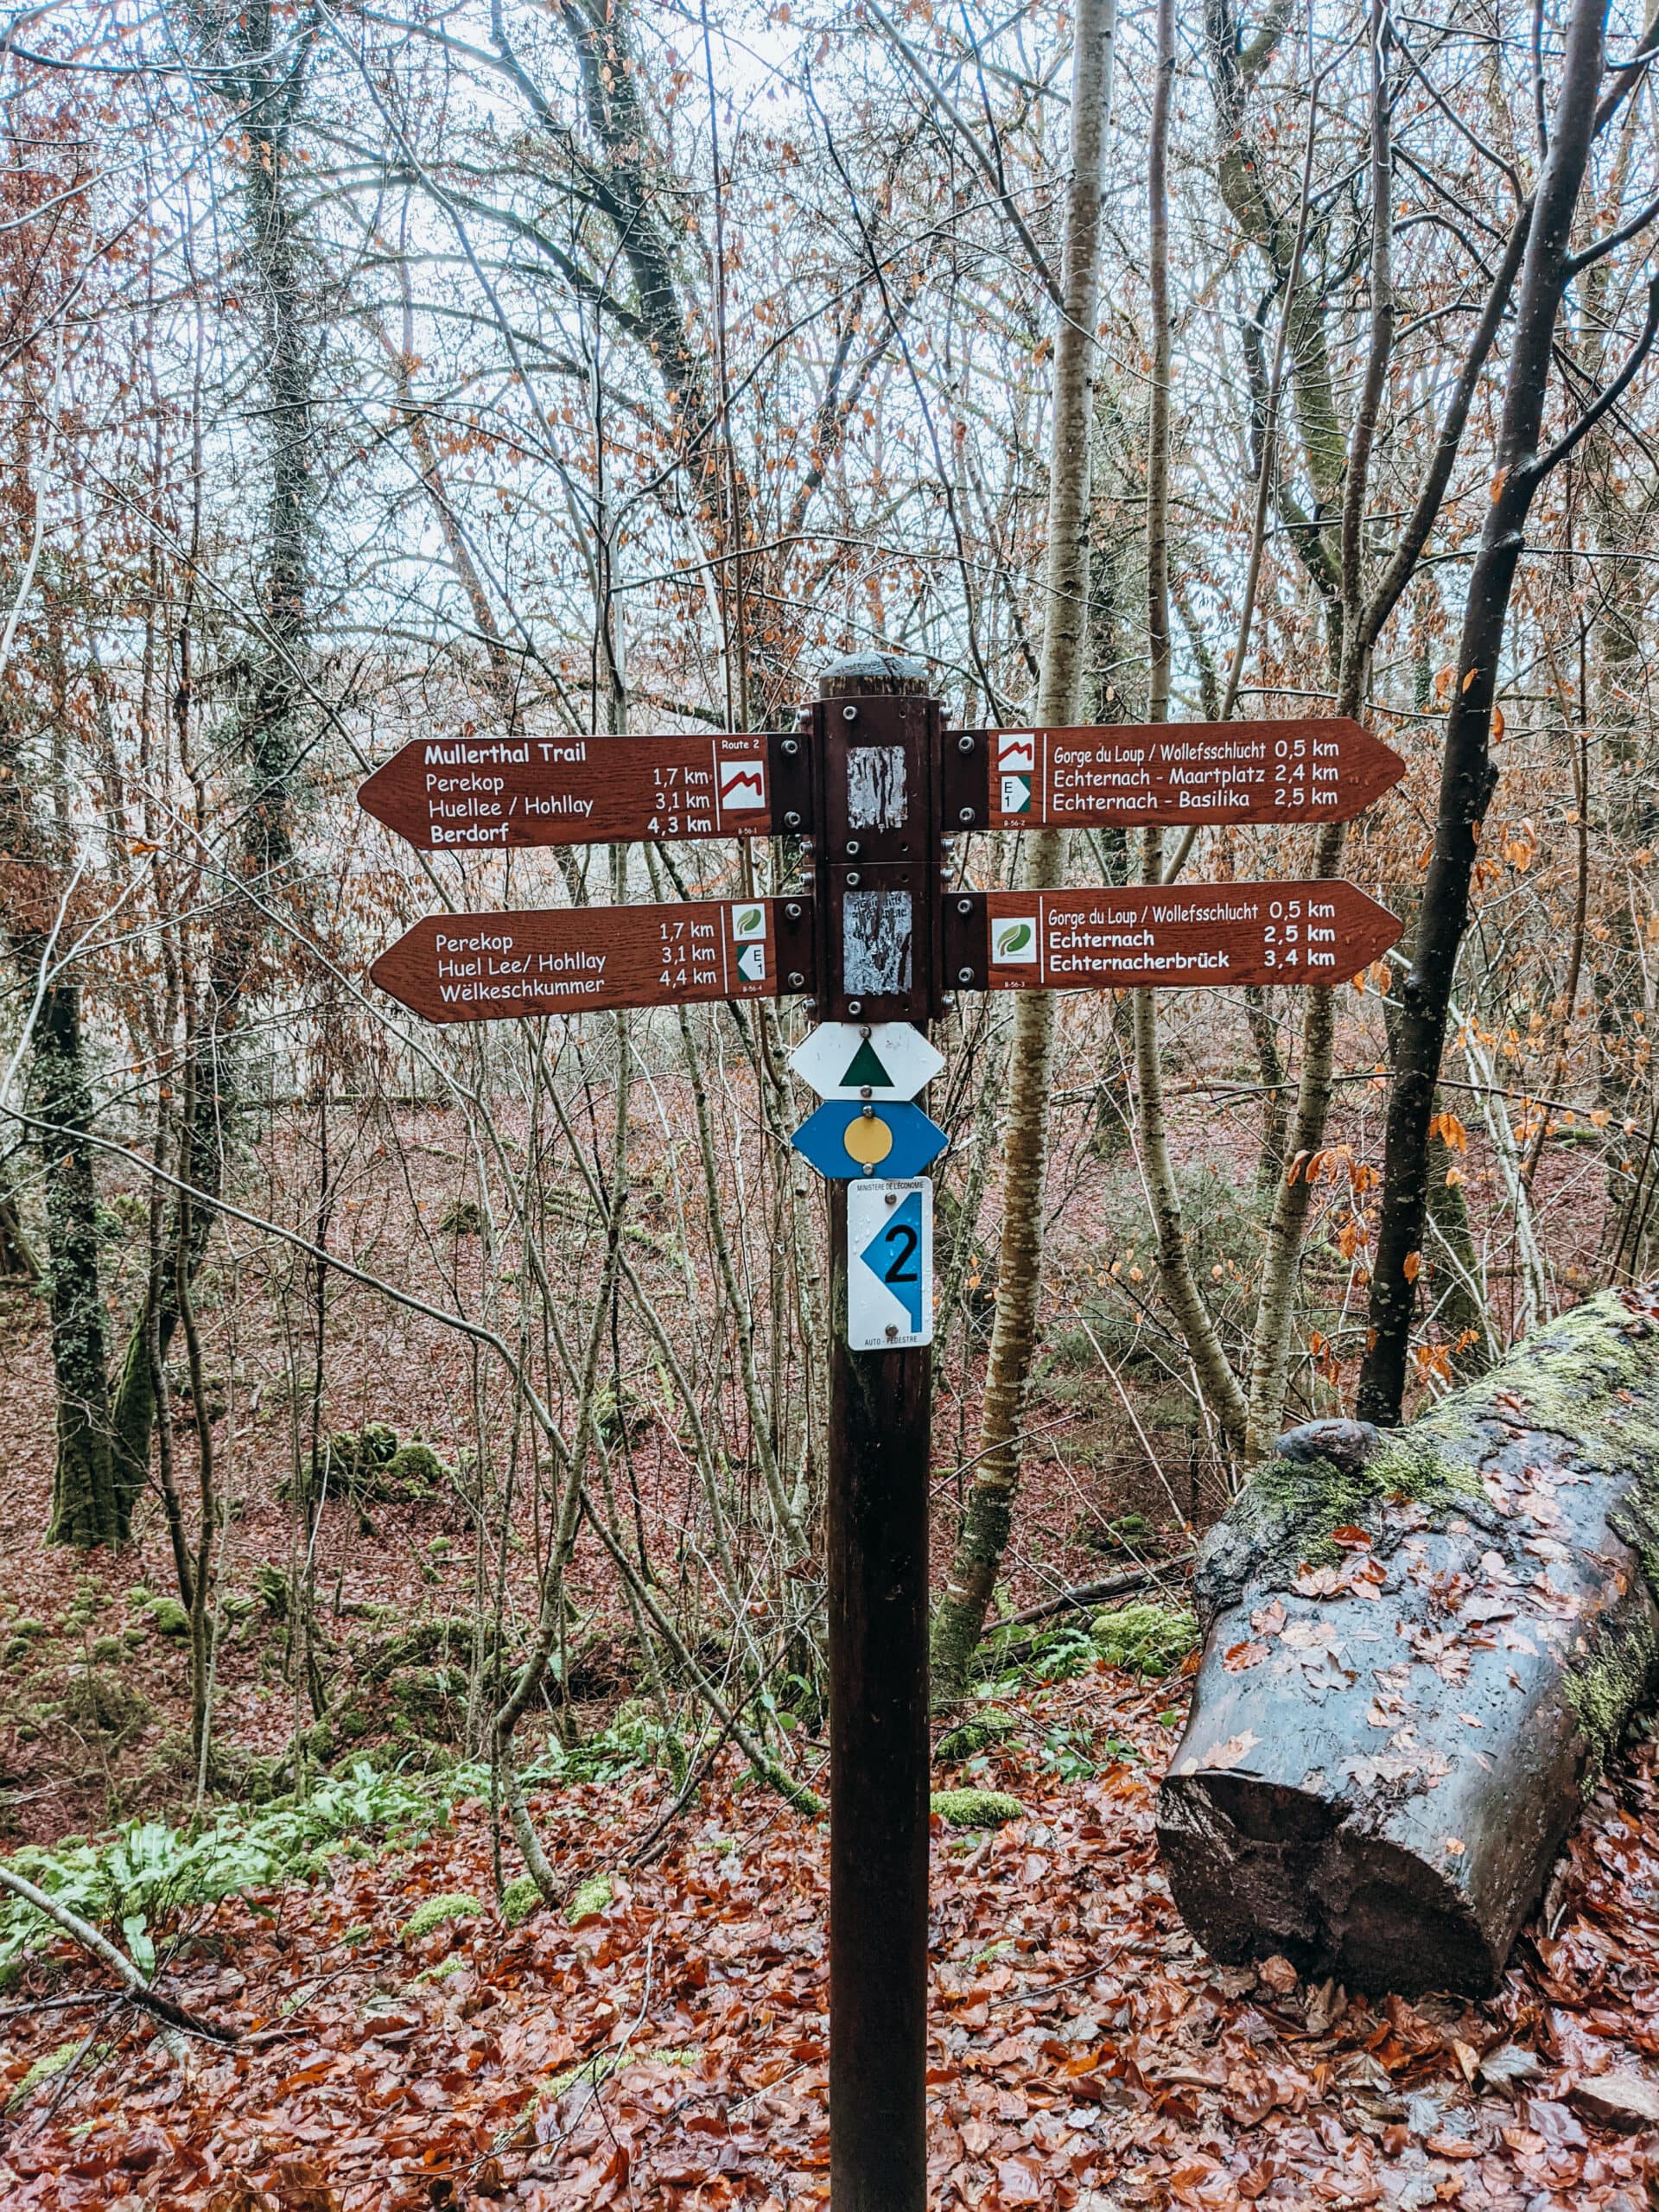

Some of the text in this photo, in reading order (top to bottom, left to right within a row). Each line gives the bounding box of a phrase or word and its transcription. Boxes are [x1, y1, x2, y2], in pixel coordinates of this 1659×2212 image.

[424, 741, 586, 765] Mullerthal Trail
[721, 739, 760, 749] Route 2
[1053, 741, 1266, 767] Gorge du Loup / Wollefsschlucht
[1274, 739, 1339, 760] 0,5 km
[426, 772, 505, 796] Perekop
[653, 766, 709, 788] 1,7 km
[1053, 768, 1150, 788] Echternach
[1169, 765, 1266, 788] Maartplatz
[1274, 763, 1338, 784] 2,4 km
[1004, 781, 1013, 794] E
[1274, 787, 1338, 808] 2,5 km
[429, 794, 594, 818] Huellee / Hohllay
[655, 791, 710, 813] 3,1 km
[1004, 795, 1010, 808] 1
[1052, 791, 1158, 811] Echternach
[1179, 789, 1249, 808] Basilika
[430, 822, 510, 843] Berdorf
[647, 815, 712, 836] 4,3 km
[1048, 903, 1258, 930] Gorge du Loup / Wollefsschlucht
[1269, 899, 1335, 921] 0,5 km
[659, 920, 715, 942] 1,7 km
[1049, 929, 1155, 949] Echternach
[1263, 924, 1335, 945] 2,5 km
[435, 932, 513, 954] Perekop
[438, 957, 481, 978] Huel
[538, 951, 606, 973] Hohllay
[661, 944, 715, 965] 3,1 km
[753, 950, 762, 962] E
[1050, 950, 1230, 972] Echternacherbrück
[1263, 948, 1335, 969] 3,4 km
[658, 967, 717, 988] 4,4 km
[758, 963, 763, 975] 1
[440, 979, 605, 1002] Wëlkeschkummer
[885, 1224, 918, 1283] 2
